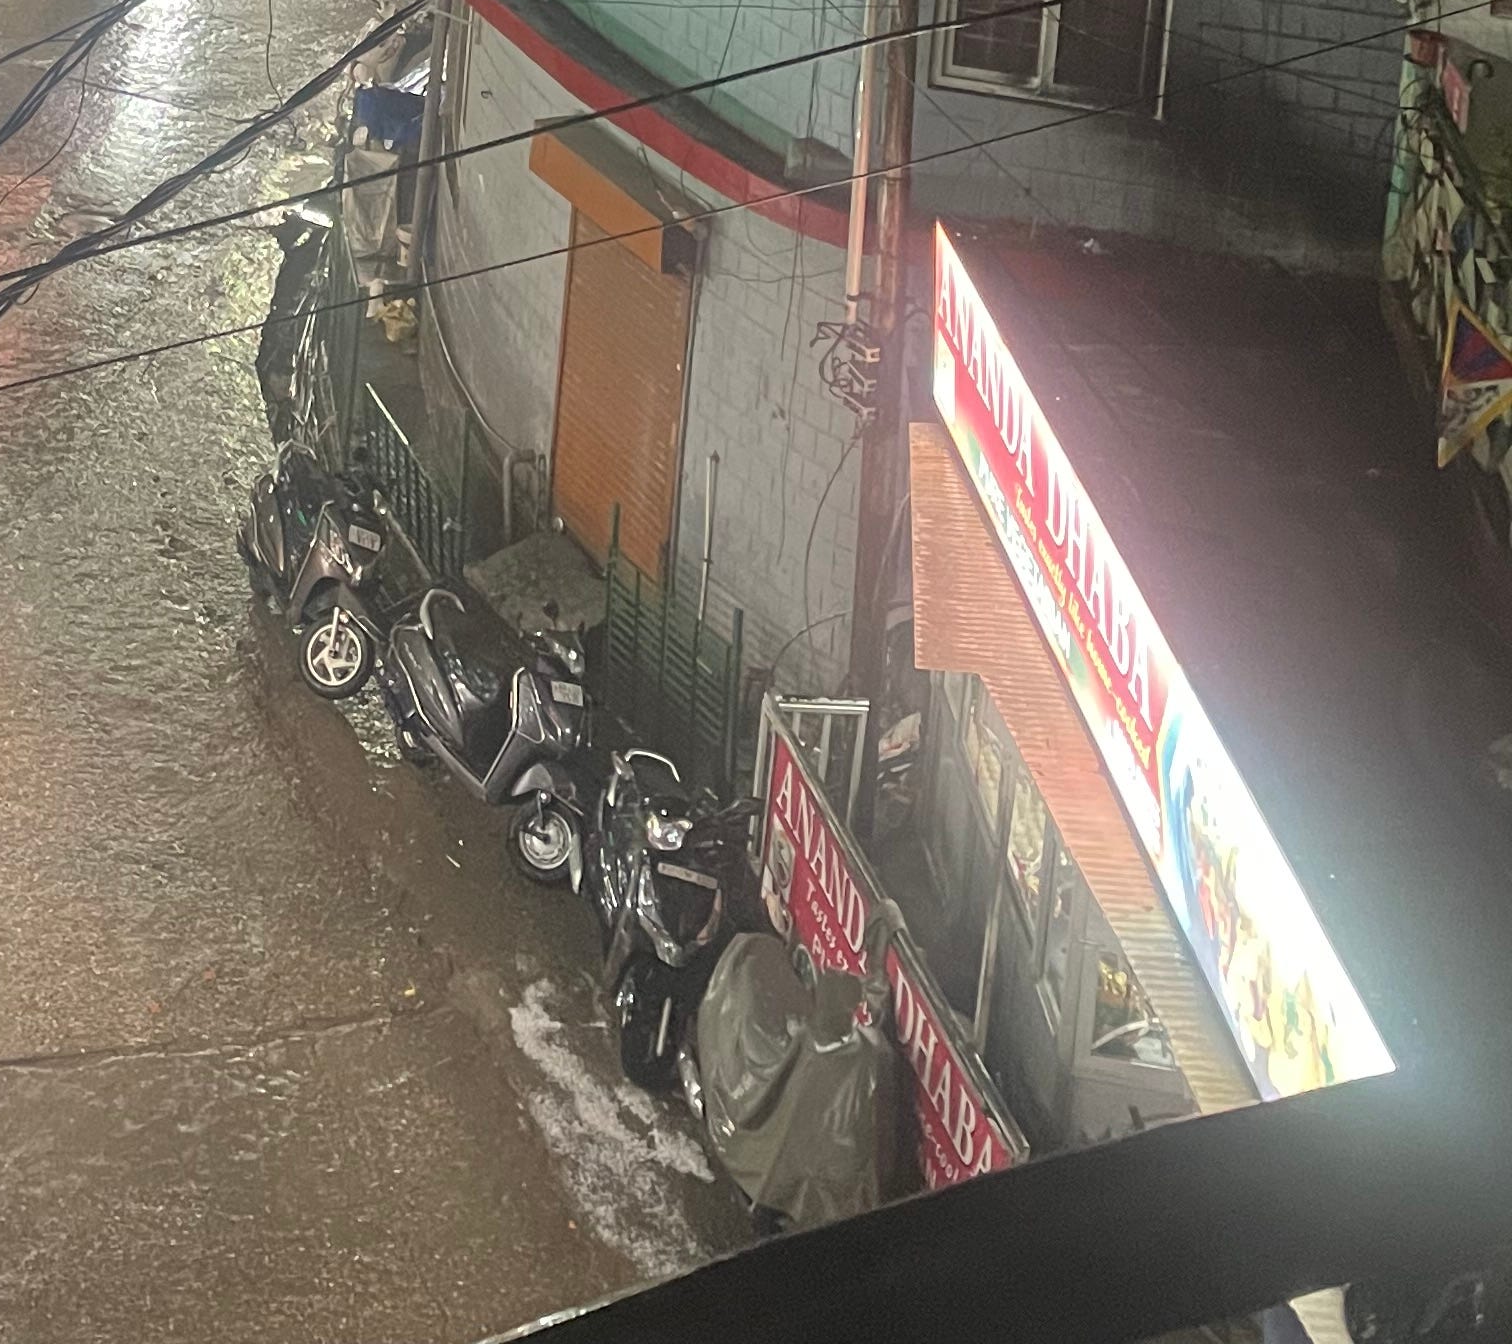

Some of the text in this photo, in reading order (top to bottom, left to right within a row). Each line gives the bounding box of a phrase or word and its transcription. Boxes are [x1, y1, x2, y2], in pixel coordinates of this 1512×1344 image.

[937, 267, 1036, 498] ANANDA
[1044, 452, 1155, 733] DHABA
[775, 761, 867, 975] ANAND
